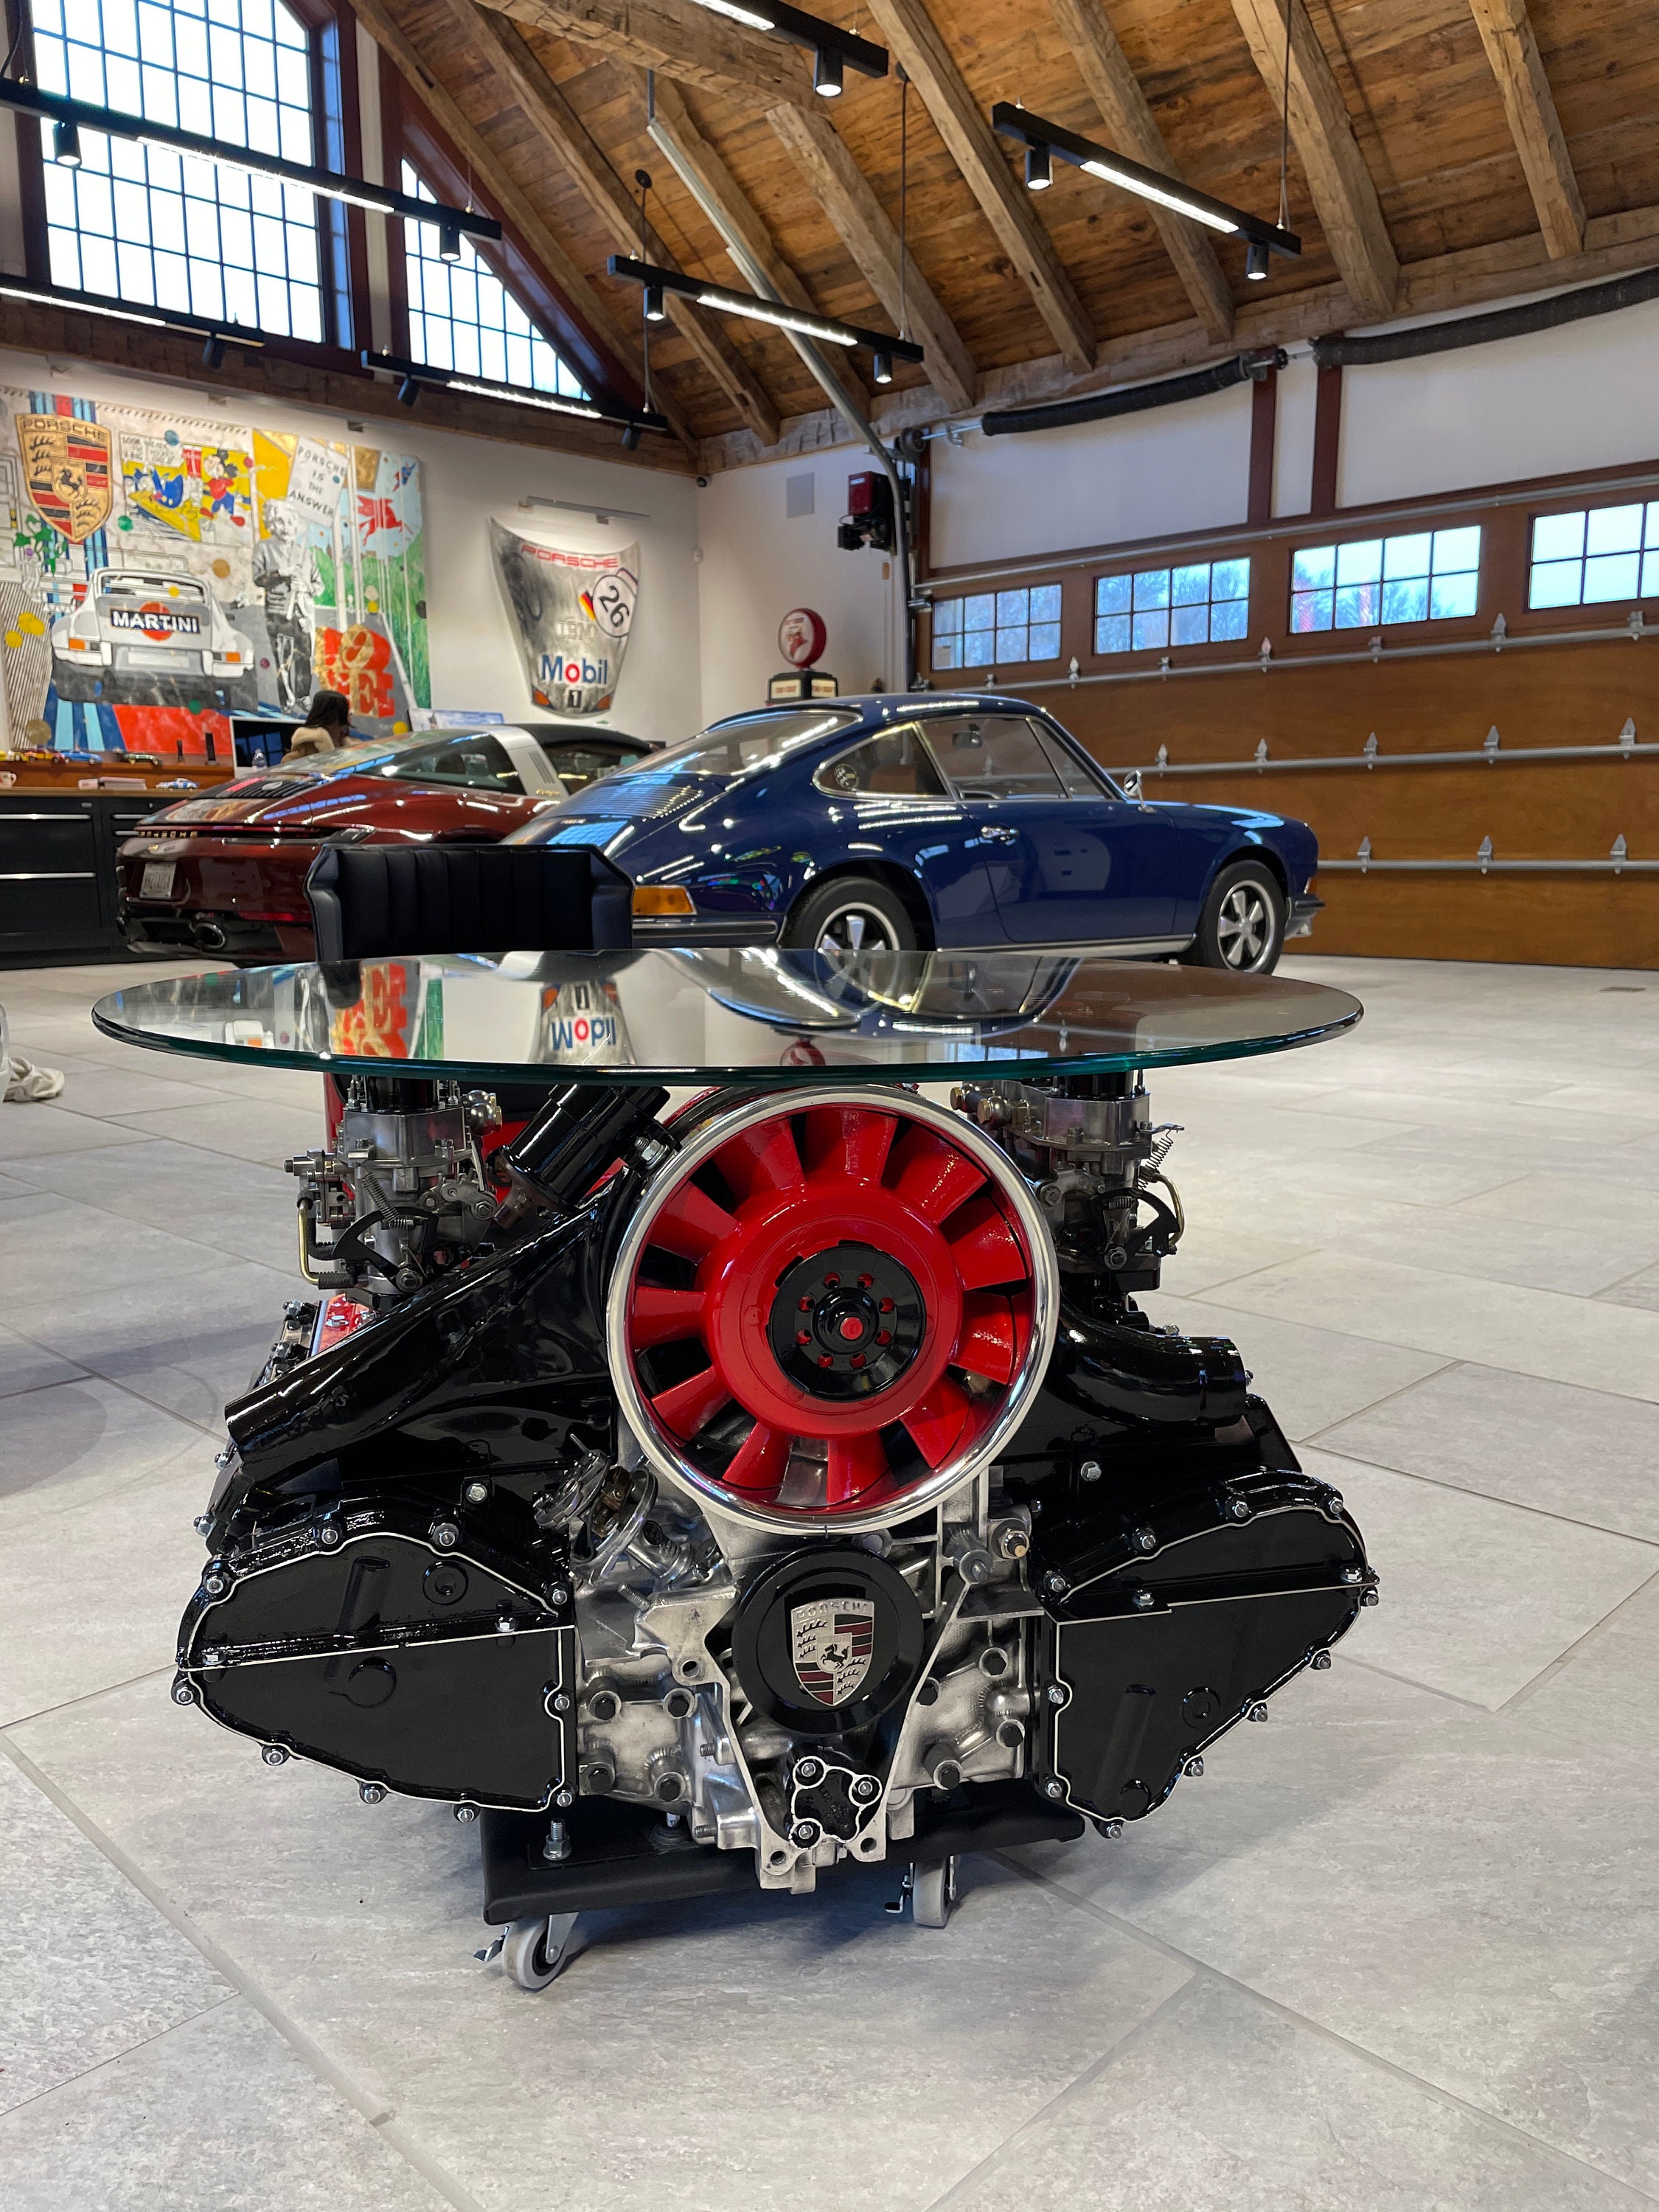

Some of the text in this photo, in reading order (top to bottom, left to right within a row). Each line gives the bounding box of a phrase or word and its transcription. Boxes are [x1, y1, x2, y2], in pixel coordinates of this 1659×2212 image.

[22, 418, 108, 445] PORSCHE
[298, 445, 347, 477] PORSCHE
[309, 481, 323, 495] THE
[313, 470, 325, 481] IS
[289, 490, 335, 518] ANSWER
[521, 544, 619, 568] PORSCHE
[598, 585, 630, 627] 26
[112, 611, 198, 633] MARTINI
[542, 654, 608, 685] Mobil
[796, 1601, 872, 1621] PORSCHE
